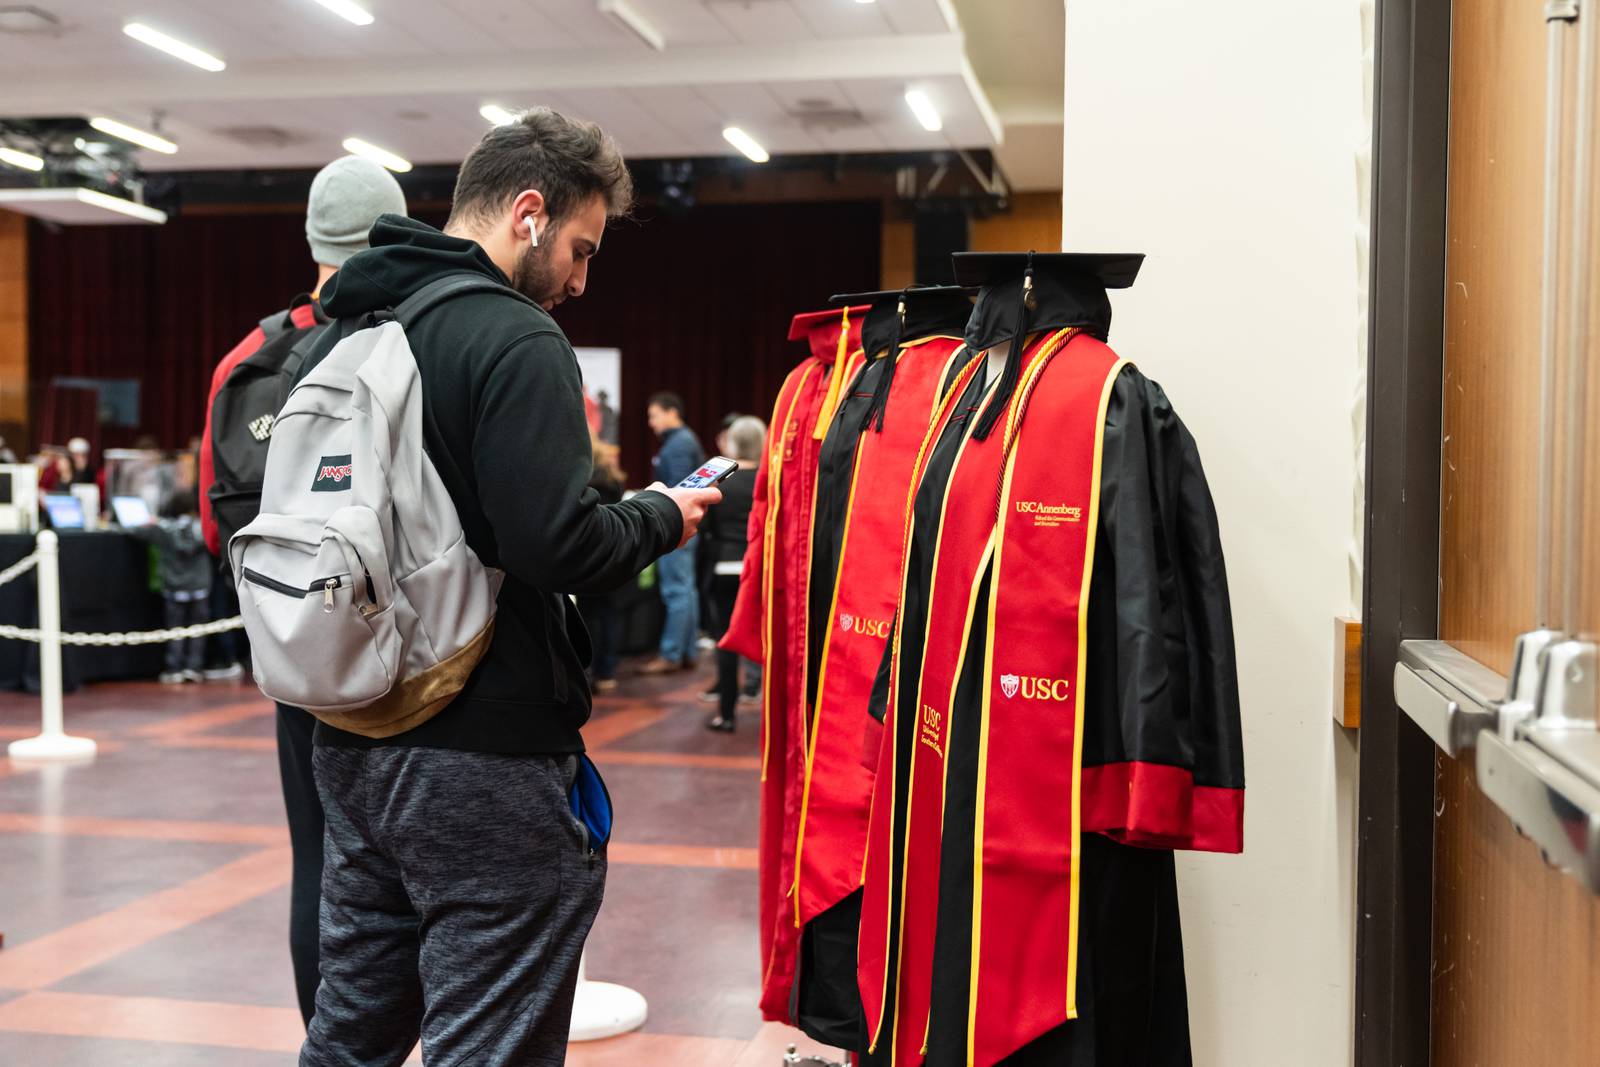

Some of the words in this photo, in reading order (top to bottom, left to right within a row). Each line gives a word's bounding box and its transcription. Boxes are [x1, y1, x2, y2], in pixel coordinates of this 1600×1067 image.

[317, 463, 352, 482] JANSPO
[1015, 501, 1037, 513] USC
[1036, 502, 1081, 518] Annenberg
[854, 616, 890, 639] USC
[1020, 676, 1069, 701] USC
[923, 704, 941, 732] USC
